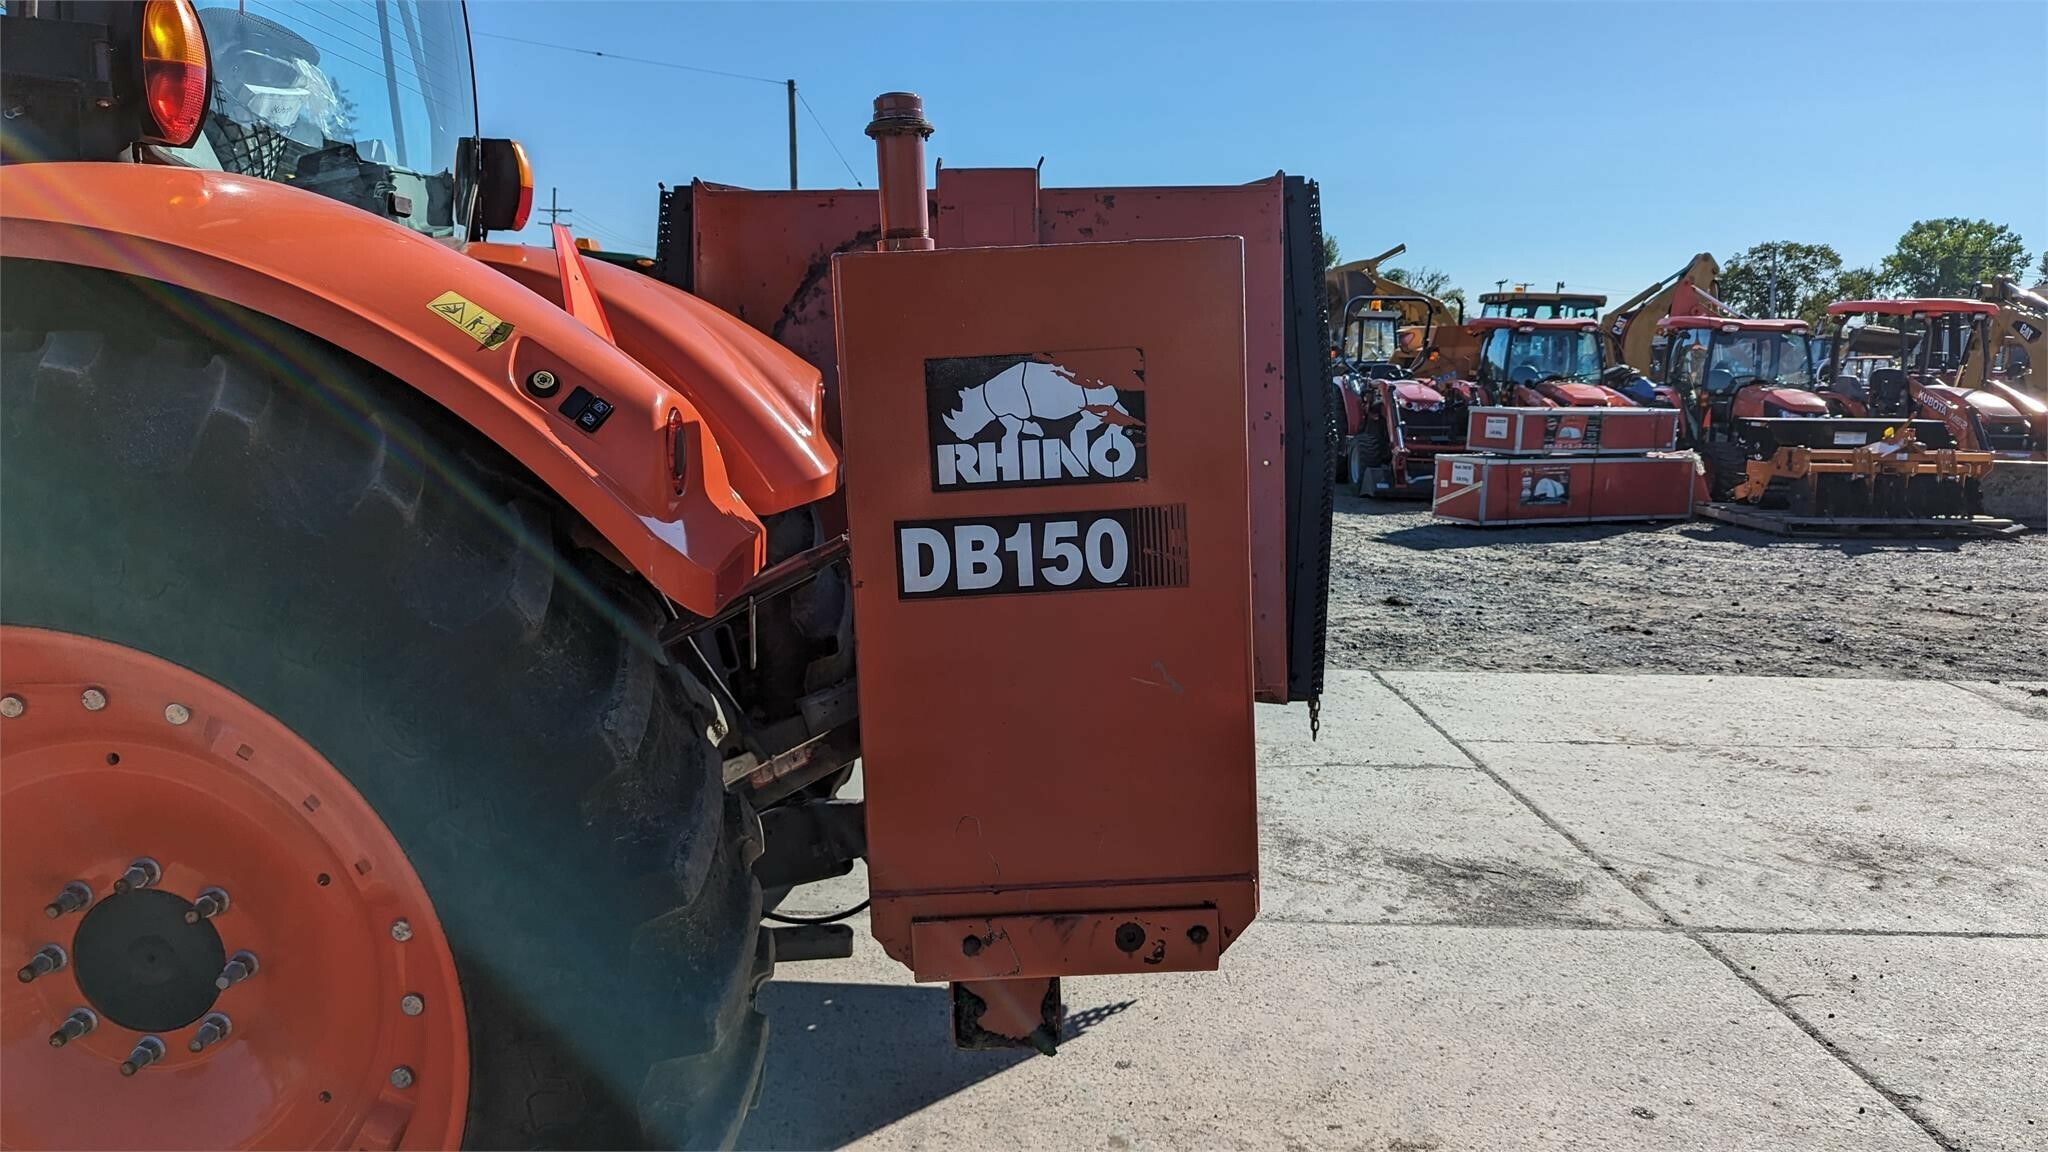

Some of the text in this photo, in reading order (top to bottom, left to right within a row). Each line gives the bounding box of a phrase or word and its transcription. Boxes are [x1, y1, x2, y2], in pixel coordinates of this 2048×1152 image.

[1612, 314, 1627, 335] CAT
[2020, 323, 2034, 340] CAT
[1918, 390, 1948, 416] KUBOTA
[937, 437, 1136, 485] RHINO
[901, 518, 1129, 593] DB150
